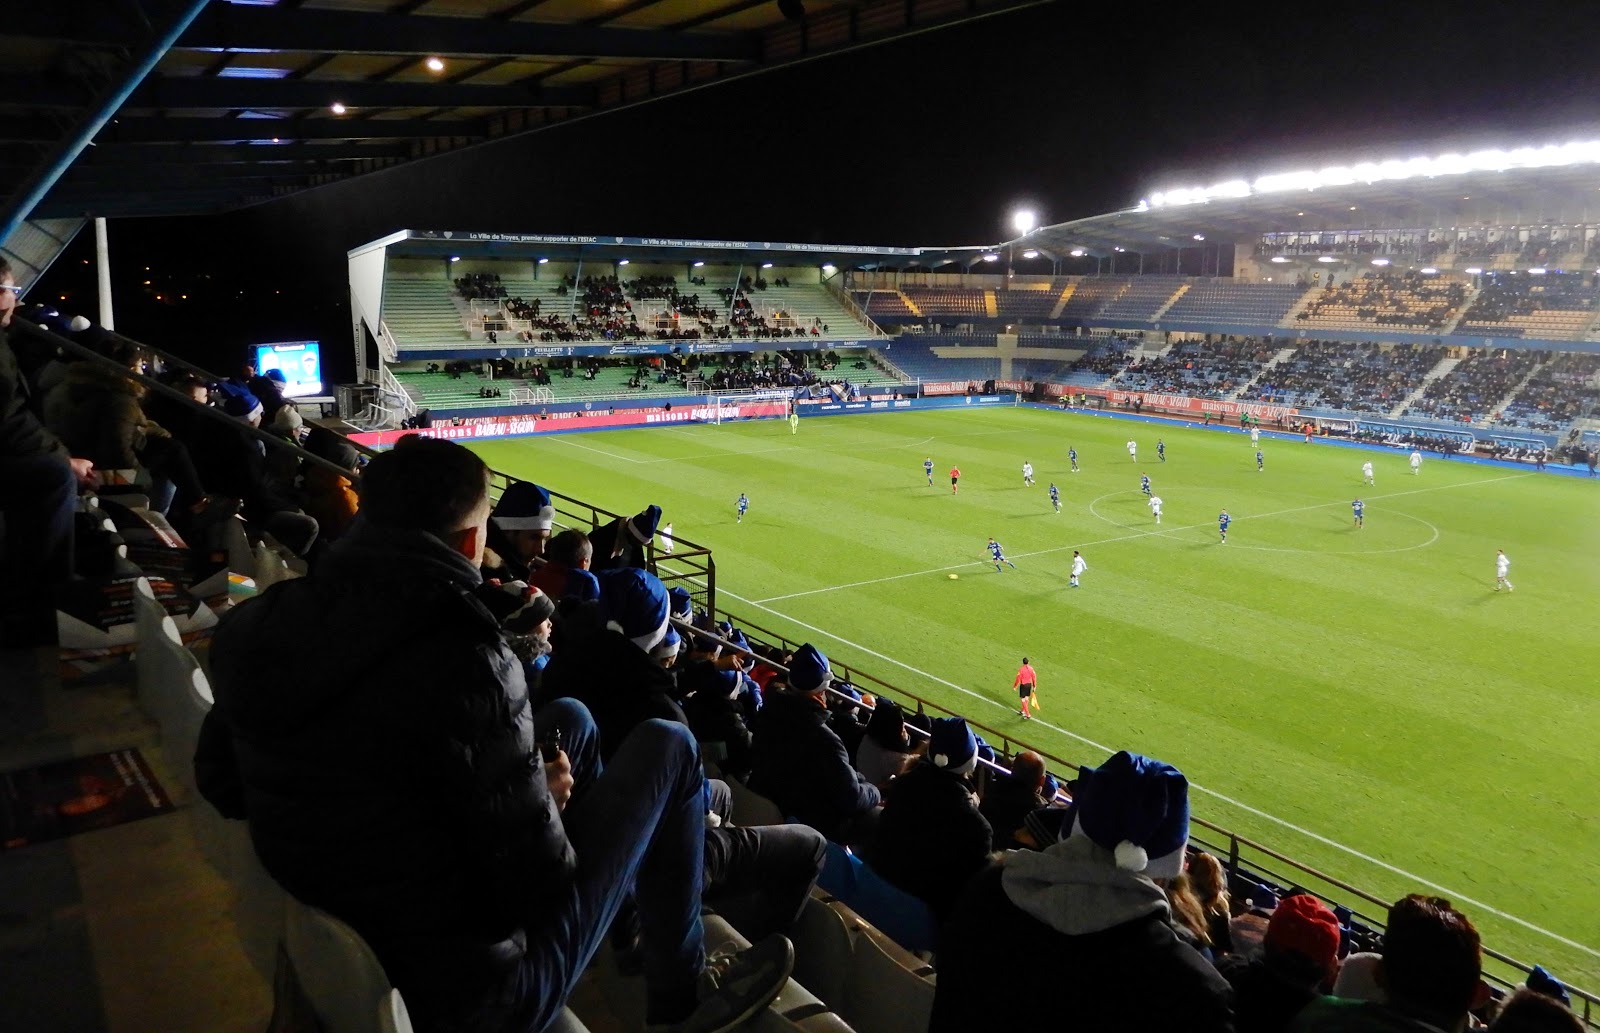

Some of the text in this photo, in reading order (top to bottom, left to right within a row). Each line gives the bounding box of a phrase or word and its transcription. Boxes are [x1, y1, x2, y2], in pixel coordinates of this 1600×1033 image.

[478, 232, 491, 240] Ville
[521, 234, 543, 243] premier
[543, 235, 569, 243] supporter
[646, 410, 689, 423] maisons
